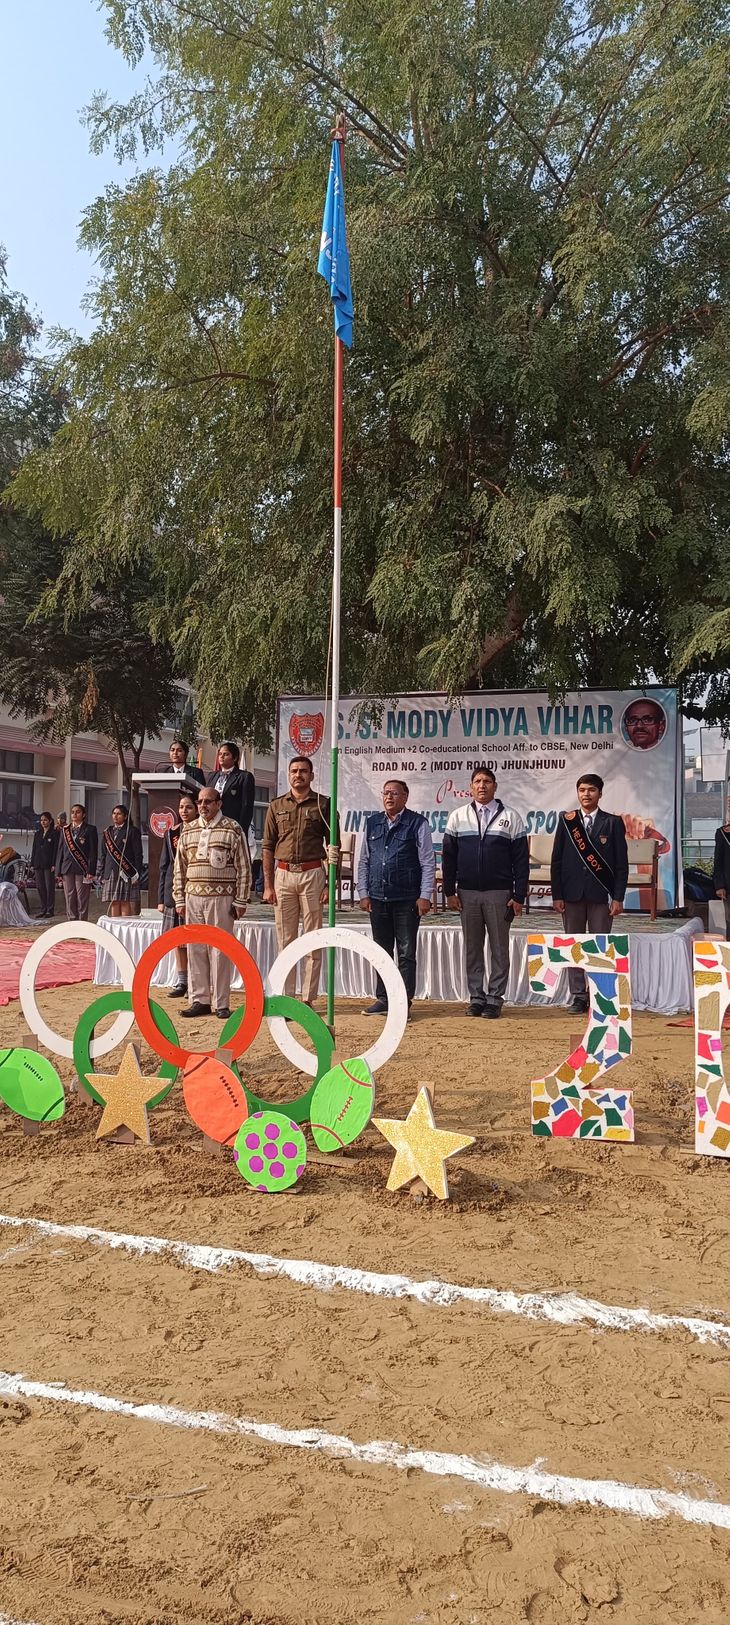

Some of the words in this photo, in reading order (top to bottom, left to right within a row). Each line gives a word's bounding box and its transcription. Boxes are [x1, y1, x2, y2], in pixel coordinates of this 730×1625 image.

[386, 710, 451, 739] MODY
[460, 707, 529, 737] VIDYA
[537, 705, 613, 736] VIHAR
[344, 746, 373, 756] English
[374, 745, 406, 754] Medium
[407, 745, 417, 754] +2
[418, 743, 480, 753] Co-educational
[481, 742, 511, 752] School
[513, 742, 527, 752] Aff.
[529, 743, 539, 752] to
[540, 742, 568, 753] CBSE,
[570, 742, 590, 751] New
[591, 741, 614, 750] Delhi
[372, 761, 398, 772] ROAD
[401, 761, 418, 772] NO.
[420, 761, 427, 771] 2
[430, 760, 464, 773] (MODY
[466, 760, 498, 772] ROAD)
[501, 759, 566, 770] JHUNJHUNU
[572, 827, 586, 850] HEAD
[586, 854, 603, 872] BOY
